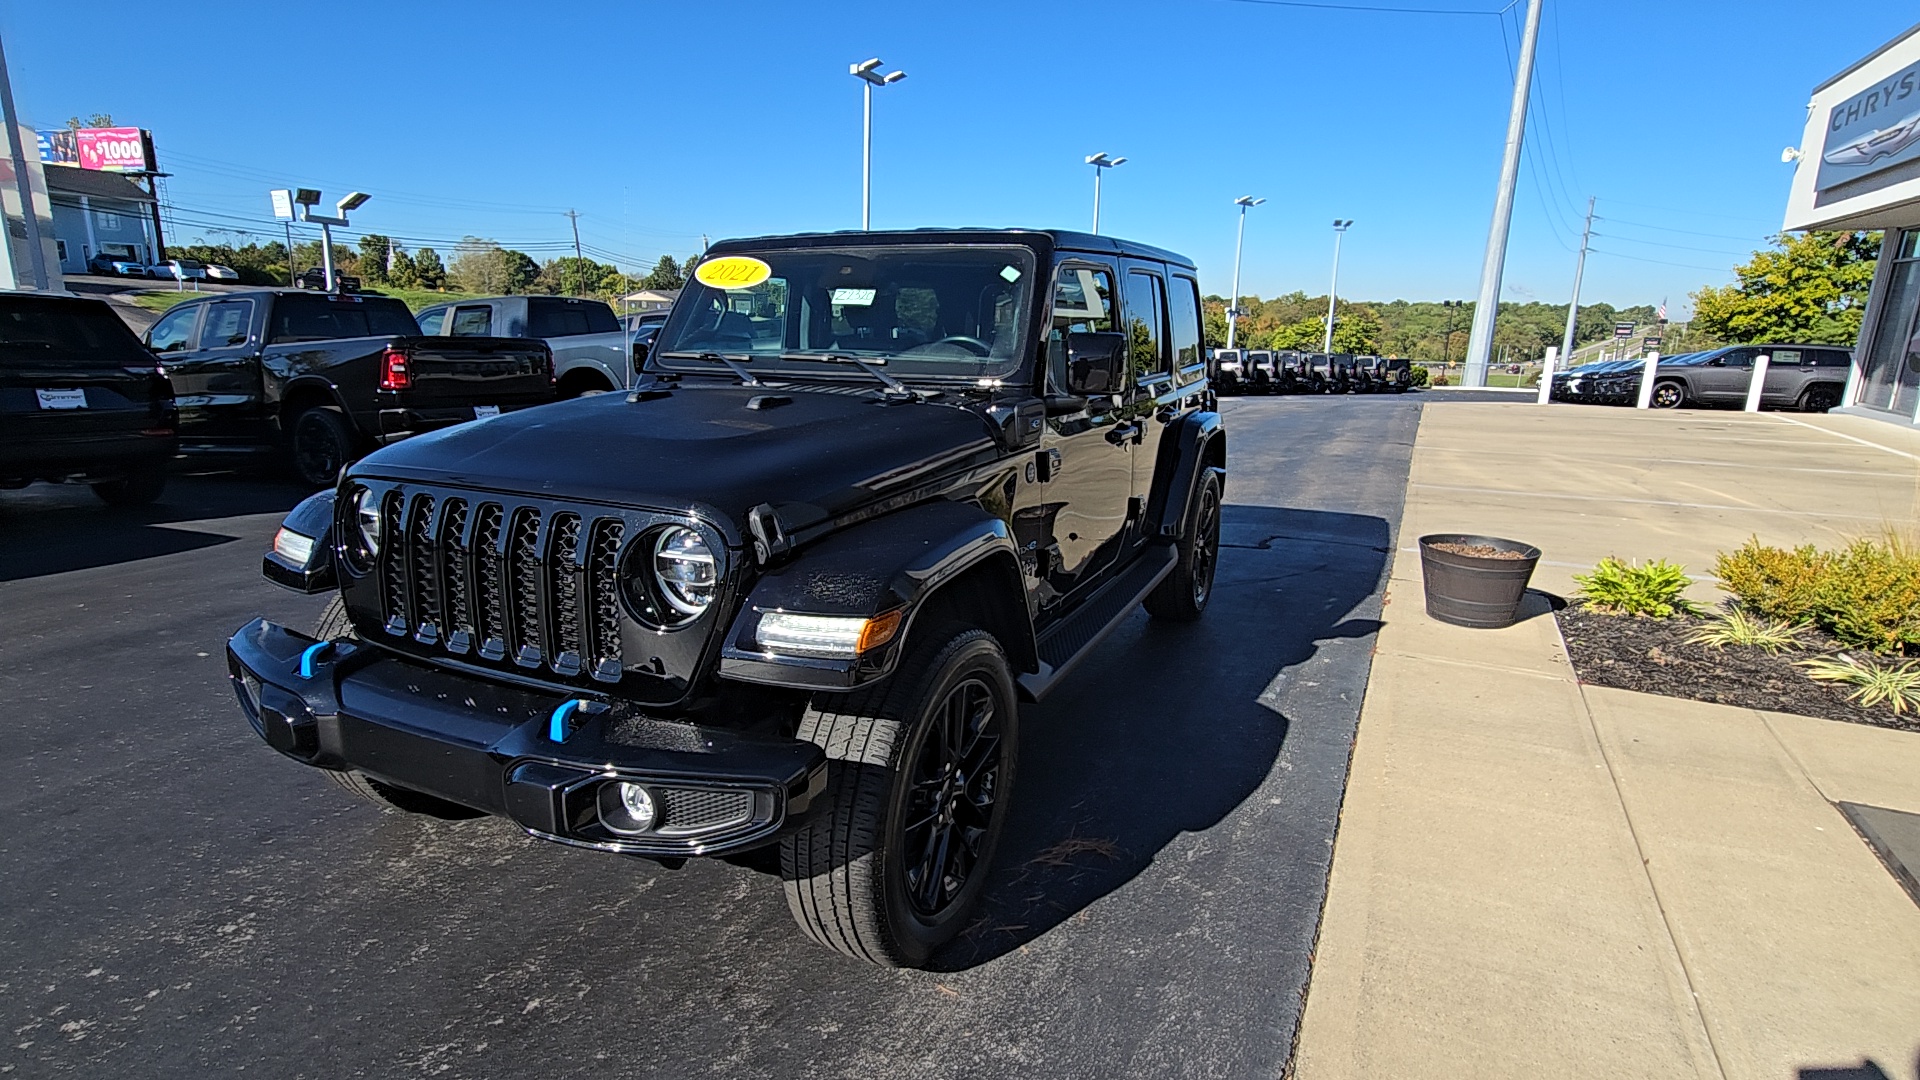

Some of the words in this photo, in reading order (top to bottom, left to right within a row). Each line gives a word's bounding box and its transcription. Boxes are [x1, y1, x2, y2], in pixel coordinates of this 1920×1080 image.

[1832, 71, 1920, 132] CHRYS
[706, 264, 759, 281] 2021
[835, 290, 874, 301] Z2320
